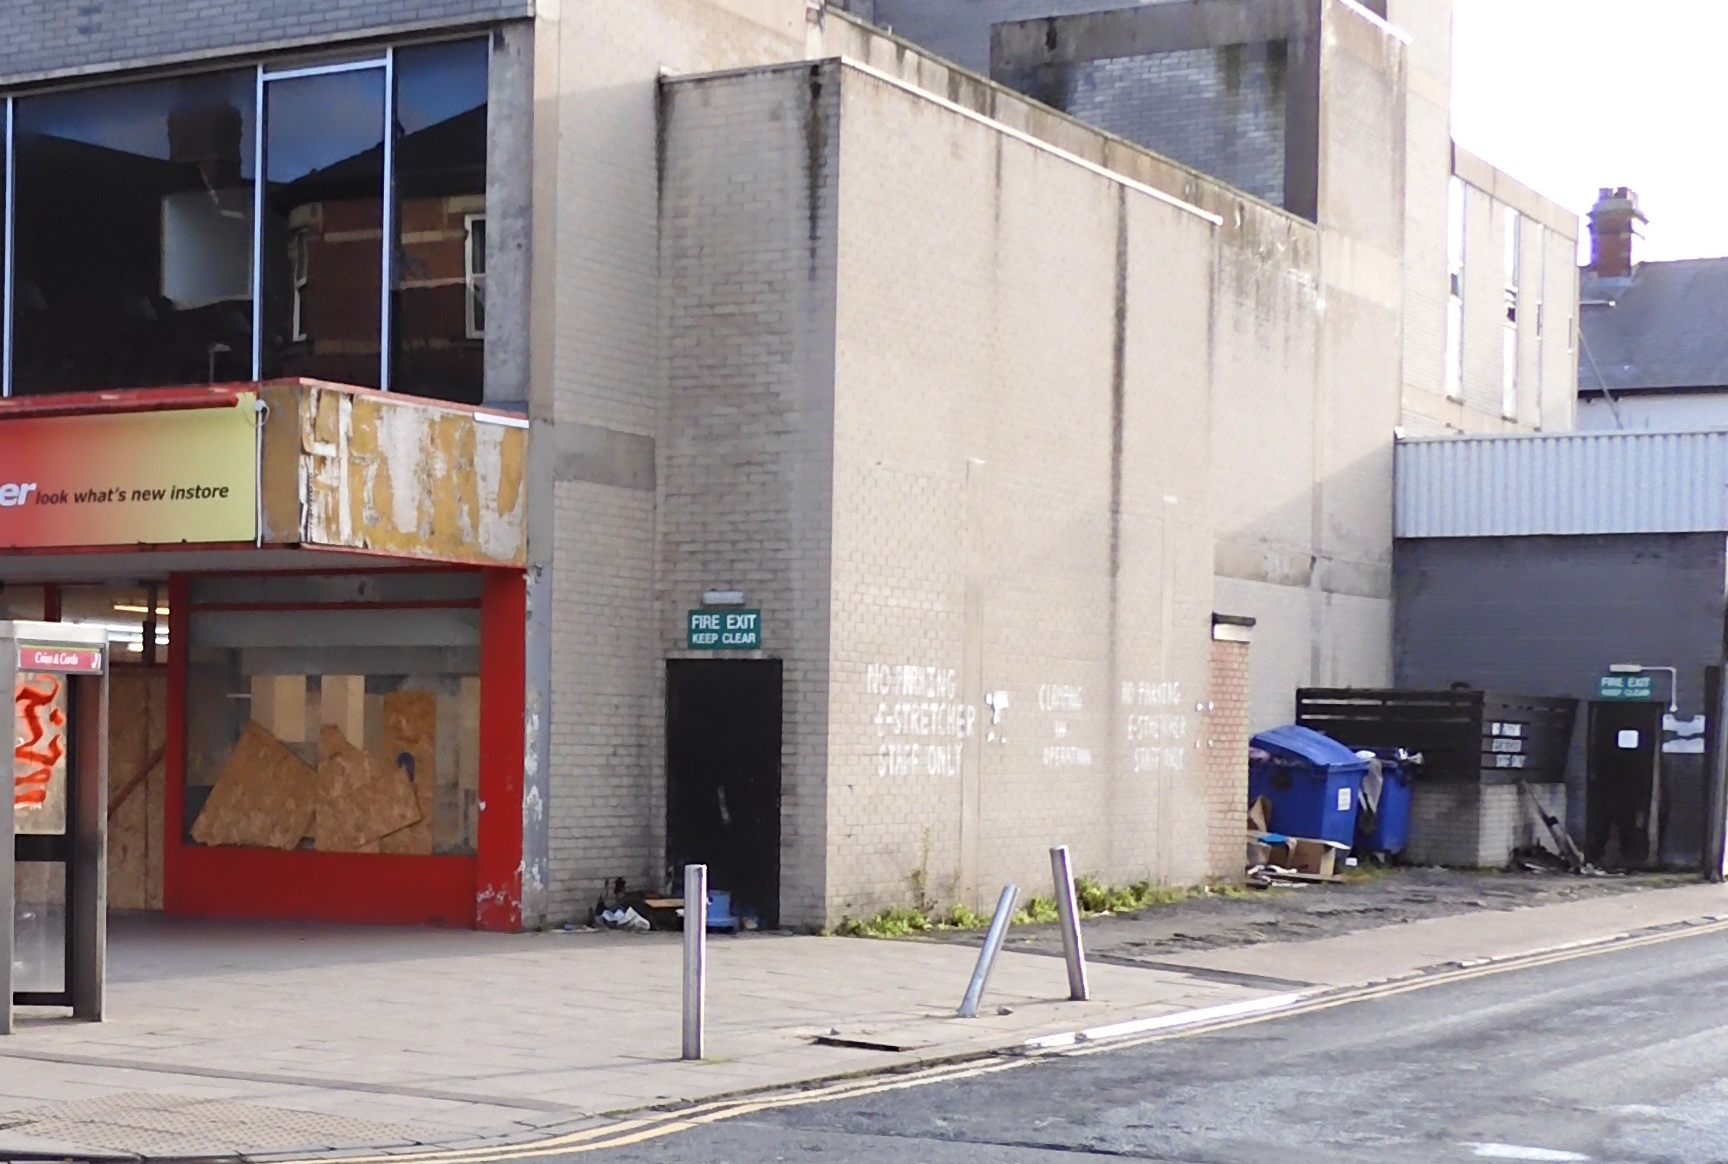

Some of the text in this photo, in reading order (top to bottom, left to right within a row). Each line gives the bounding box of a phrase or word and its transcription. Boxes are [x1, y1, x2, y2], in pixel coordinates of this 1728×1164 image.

[35, 484, 229, 505] look what's new instore
[691, 614, 757, 629] FIRE EXIT
[692, 632, 756, 644] KEEP CLEAR
[867, 663, 891, 695] NO
[1601, 676, 1650, 687] FIRE EXIT
